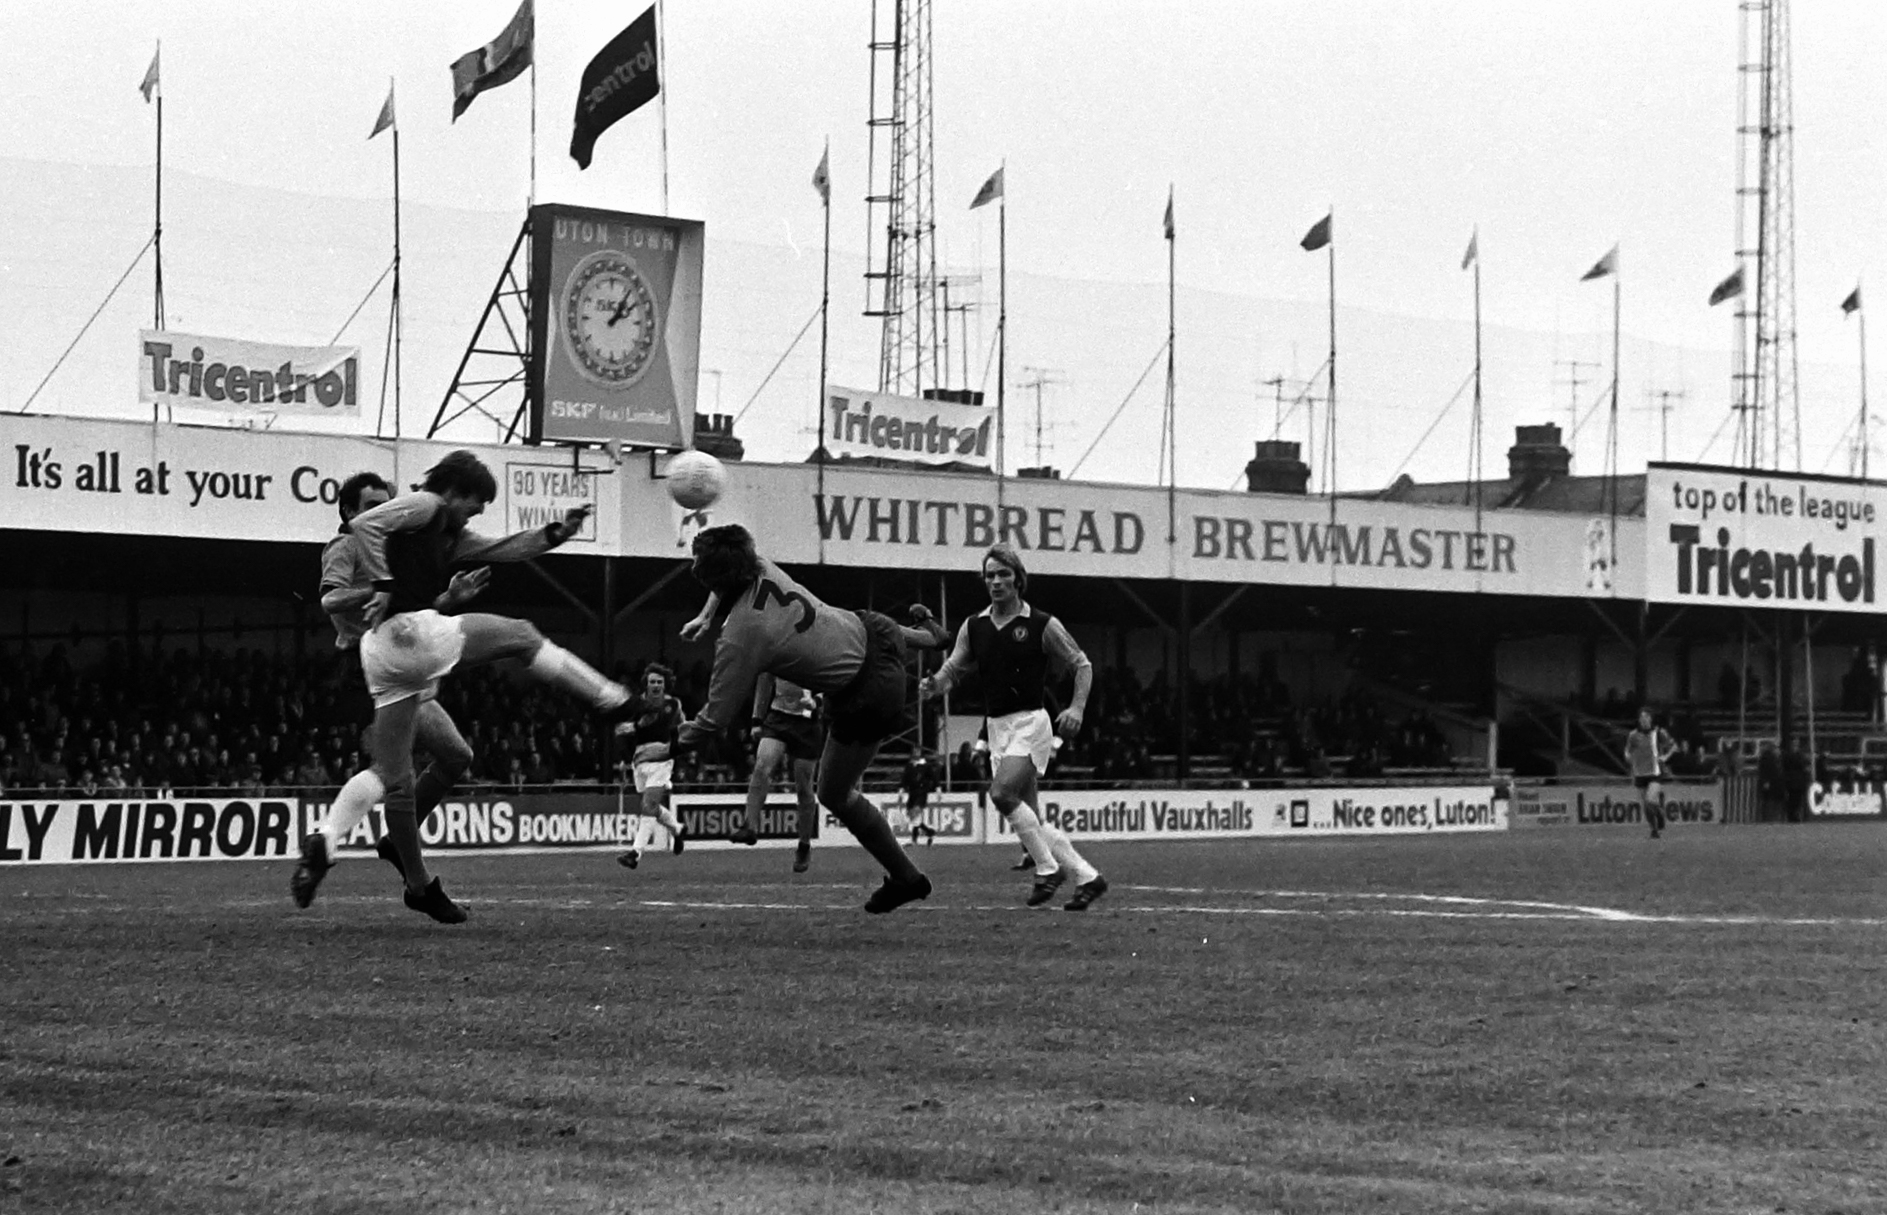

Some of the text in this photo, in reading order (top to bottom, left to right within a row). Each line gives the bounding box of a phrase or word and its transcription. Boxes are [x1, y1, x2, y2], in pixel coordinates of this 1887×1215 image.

[554, 217, 607, 245] UTON
[143, 340, 358, 408] Tricentrol
[830, 395, 992, 457] Tricentrol
[15, 445, 340, 507] It's all at your Co
[541, 472, 589, 498] YEARS
[518, 506, 564, 530] WINN
[1673, 481, 1875, 530] top of the league
[813, 493, 1517, 573] WHITBREAD BREWMASTER
[1669, 523, 1875, 604] Tricentrol
[0, 801, 291, 861] LY MIRROR
[306, 801, 641, 846] HATORNS BOOKMAKER
[683, 810, 744, 835] VISIO
[759, 809, 799, 834] HIR
[1046, 801, 1147, 833] Beautiful
[1151, 800, 1254, 832] Vauxhalls
[1577, 792, 1642, 823] Luton
